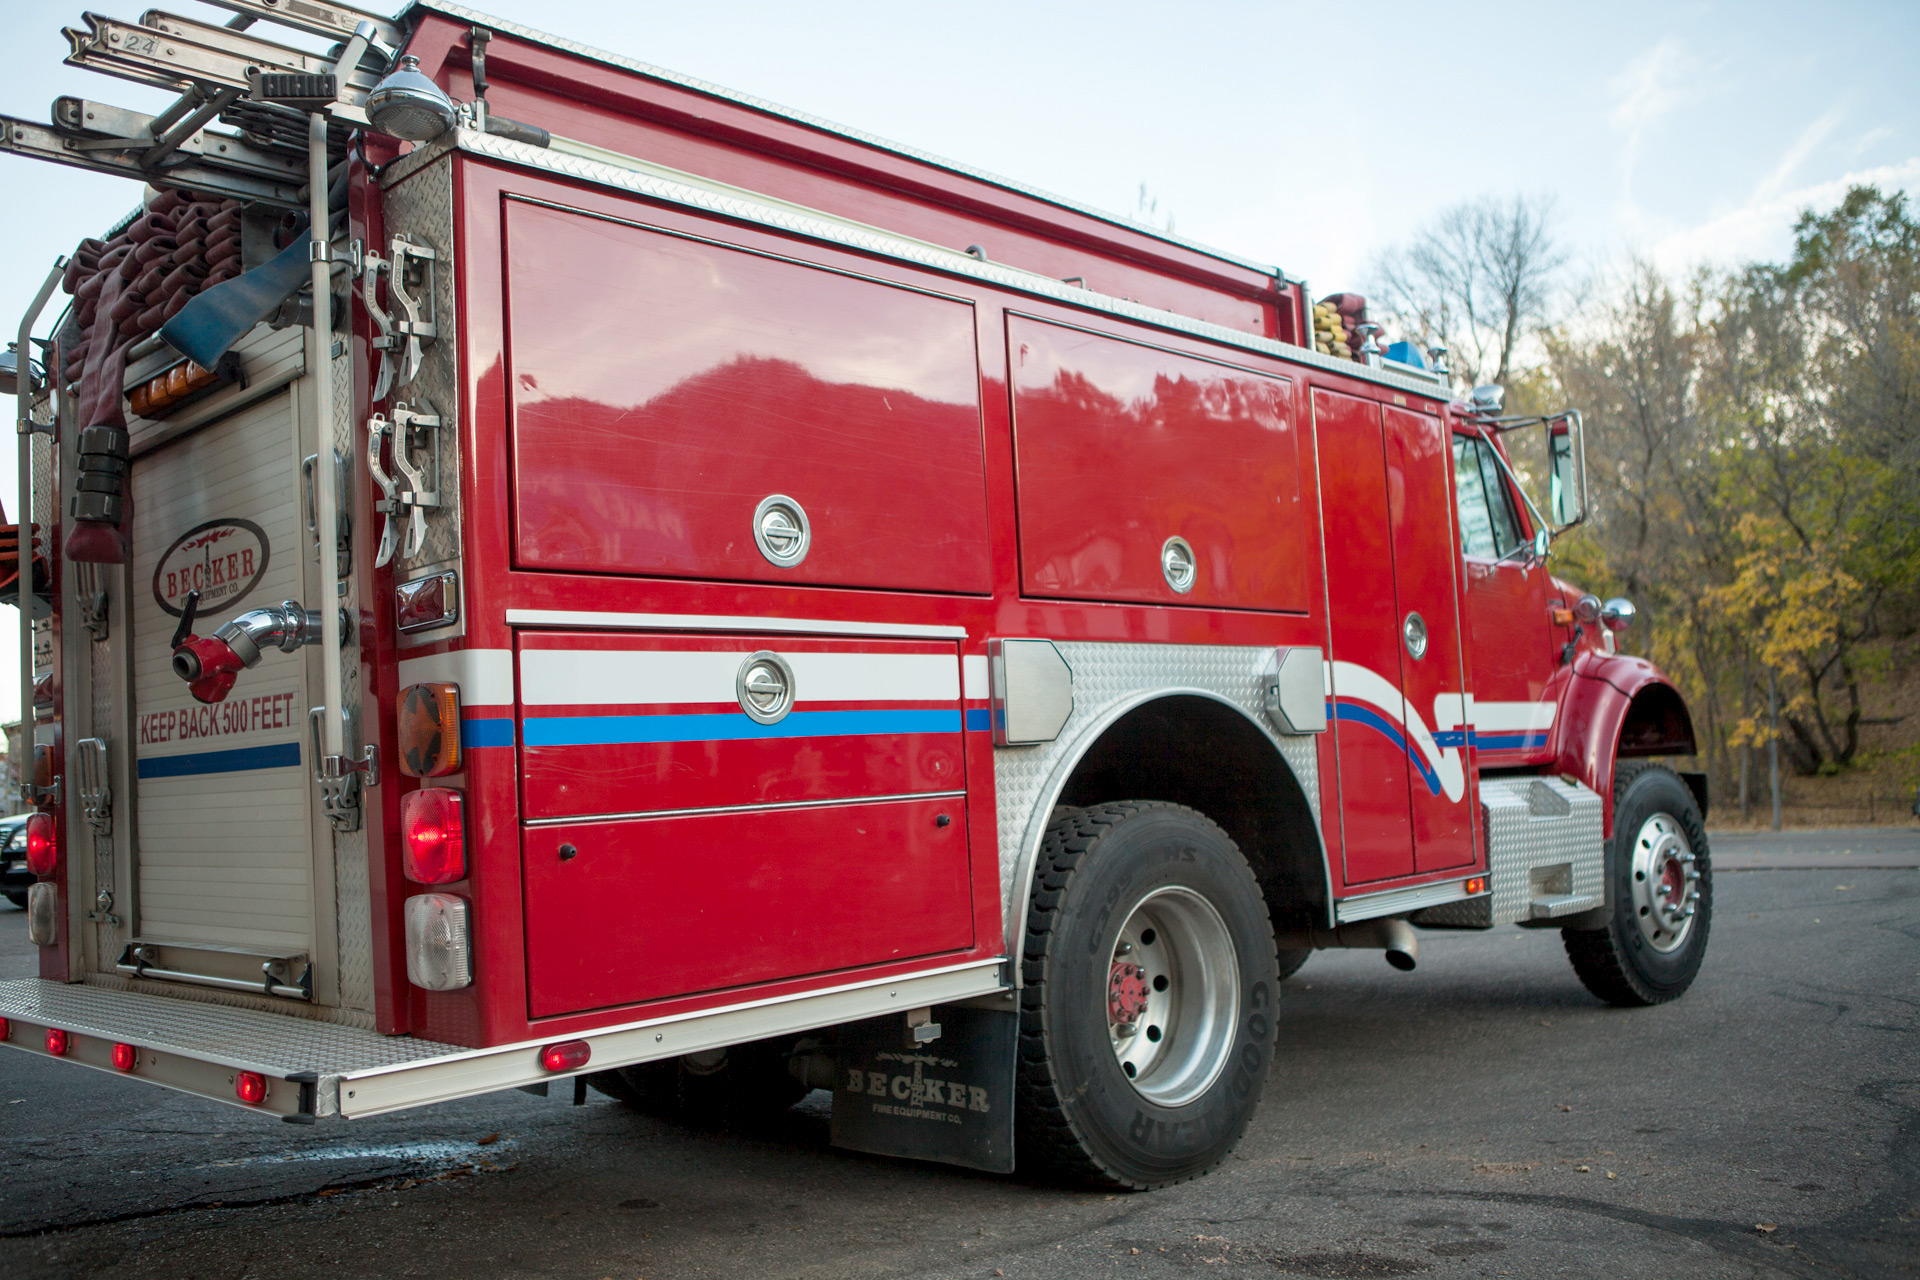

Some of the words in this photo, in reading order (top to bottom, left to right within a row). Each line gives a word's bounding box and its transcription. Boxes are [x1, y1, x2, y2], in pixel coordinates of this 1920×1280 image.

[126, 35, 155, 55] 24
[167, 548, 256, 599] BECKER
[141, 710, 176, 745] KEEP
[179, 703, 220, 740] BACK
[223, 700, 248, 735] 500
[252, 692, 294, 731] FEET
[1129, 981, 1270, 1147] GOODYEAR
[847, 1069, 990, 1113] BECKER
[872, 1103, 893, 1115] FIRE
[893, 1106, 948, 1122] EQUIPMENT
